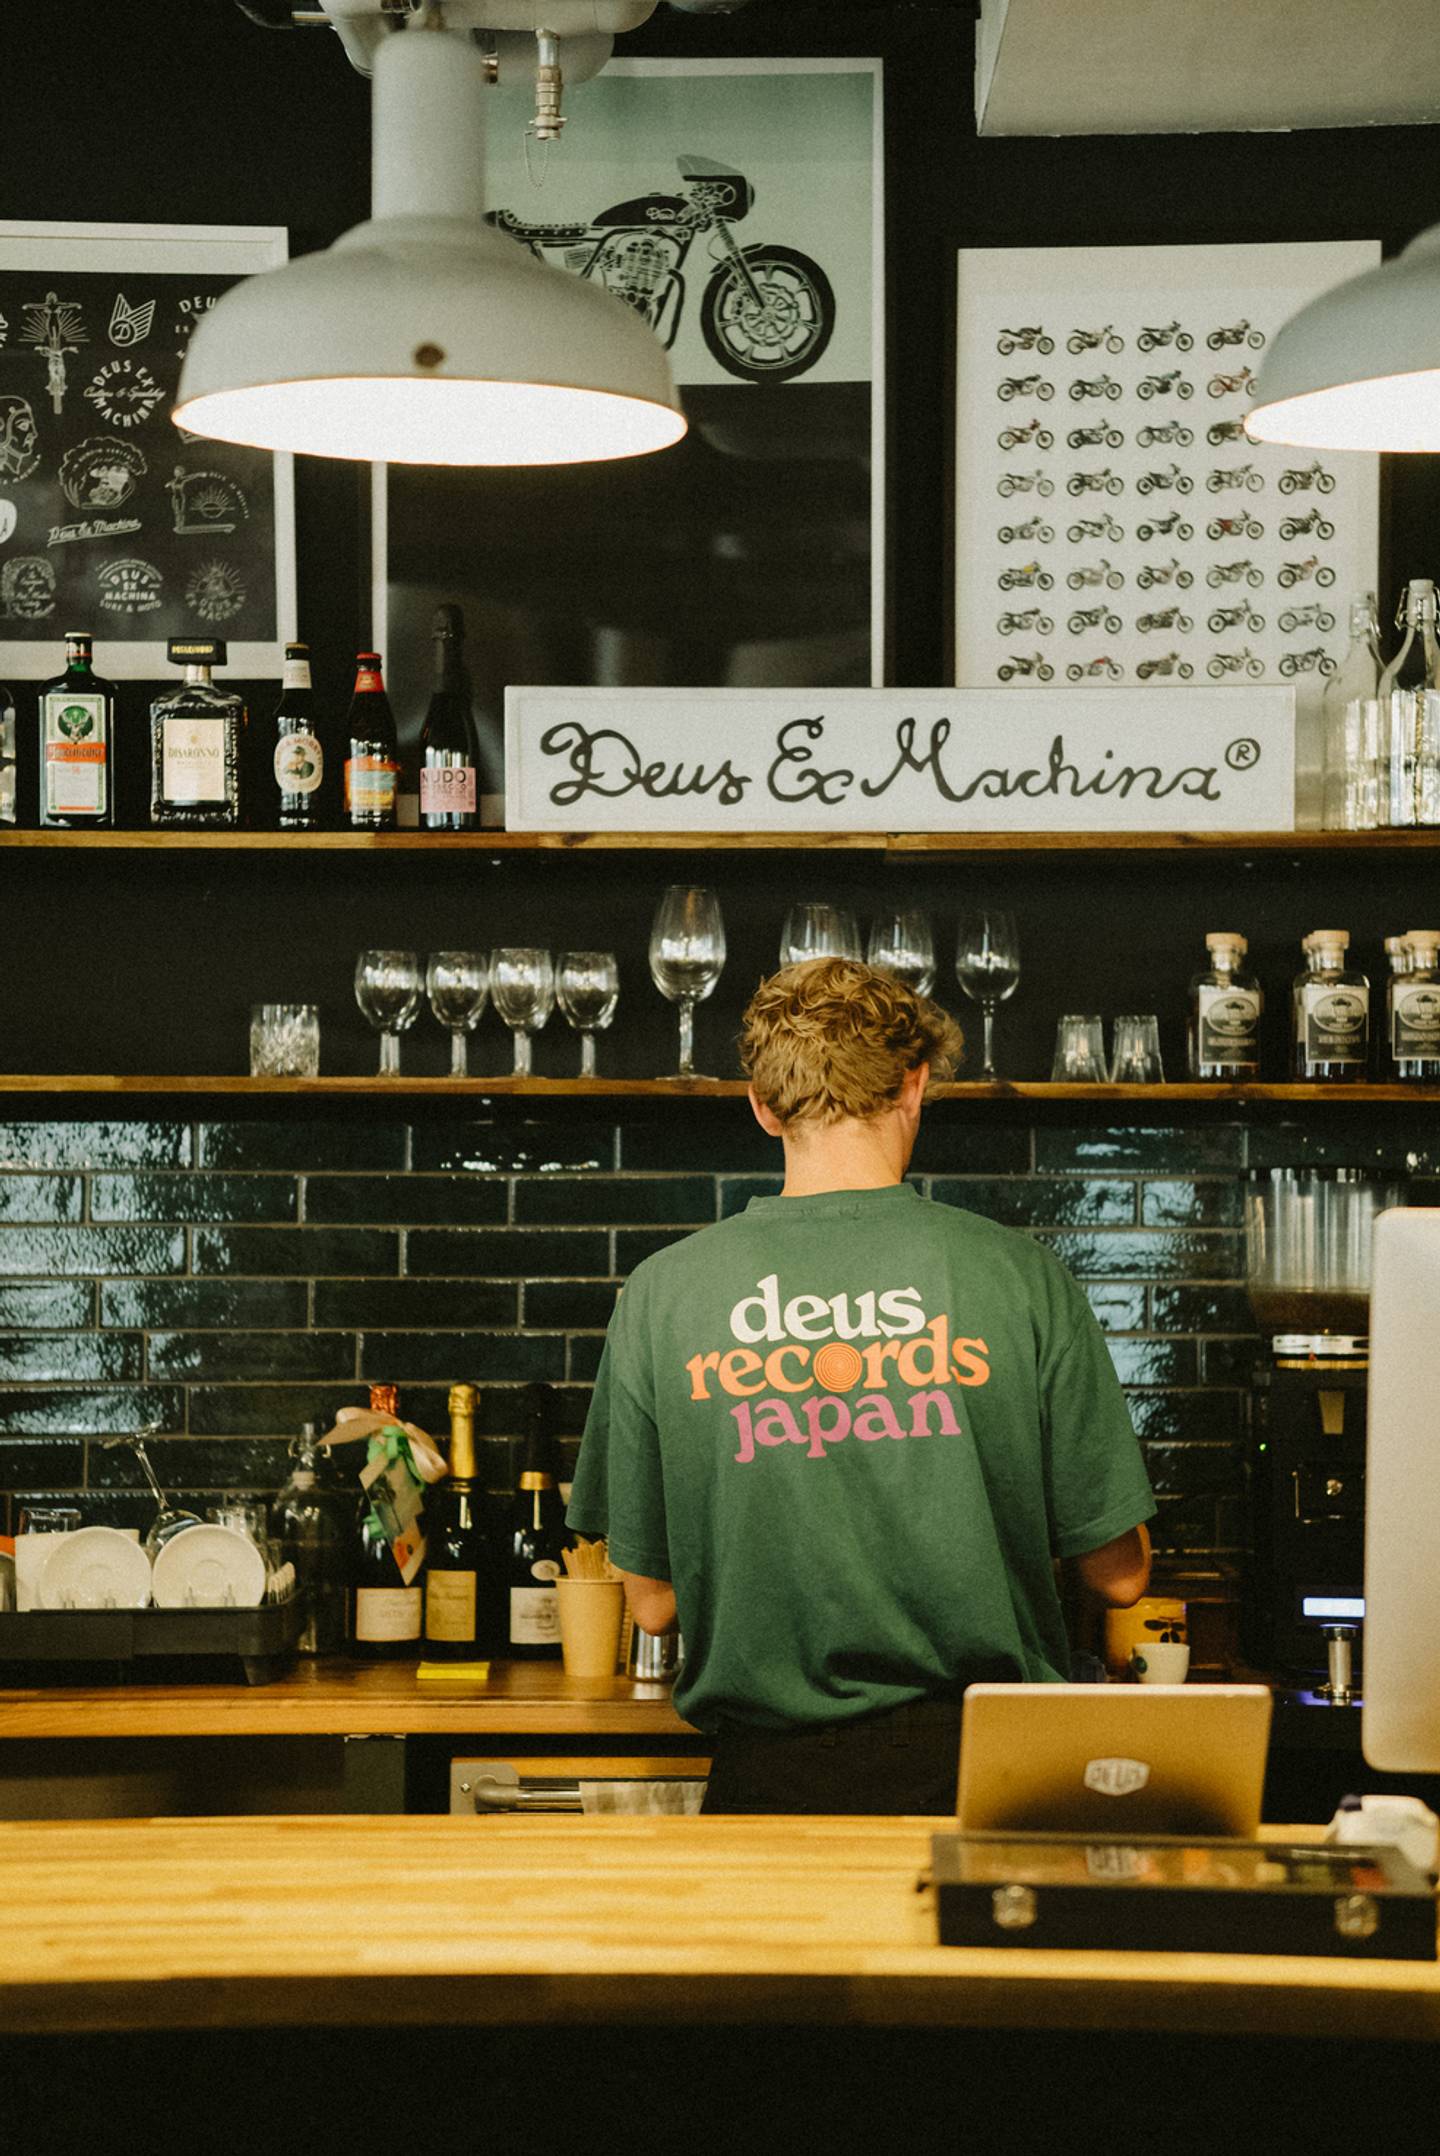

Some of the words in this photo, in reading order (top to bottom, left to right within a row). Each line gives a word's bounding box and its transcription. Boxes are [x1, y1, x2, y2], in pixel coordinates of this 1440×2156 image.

[179, 296, 217, 313] DEU
[92, 360, 132, 386] DEUS
[135, 366, 155, 387] EX
[93, 397, 155, 427] MACHINA
[104, 591, 156, 601] MACHINA
[541, 722, 752, 806] Deus
[767, 716, 854, 804] Ex
[729, 1274, 927, 1343] deus
[685, 1313, 990, 1401] records
[729, 1389, 962, 1463] japan
